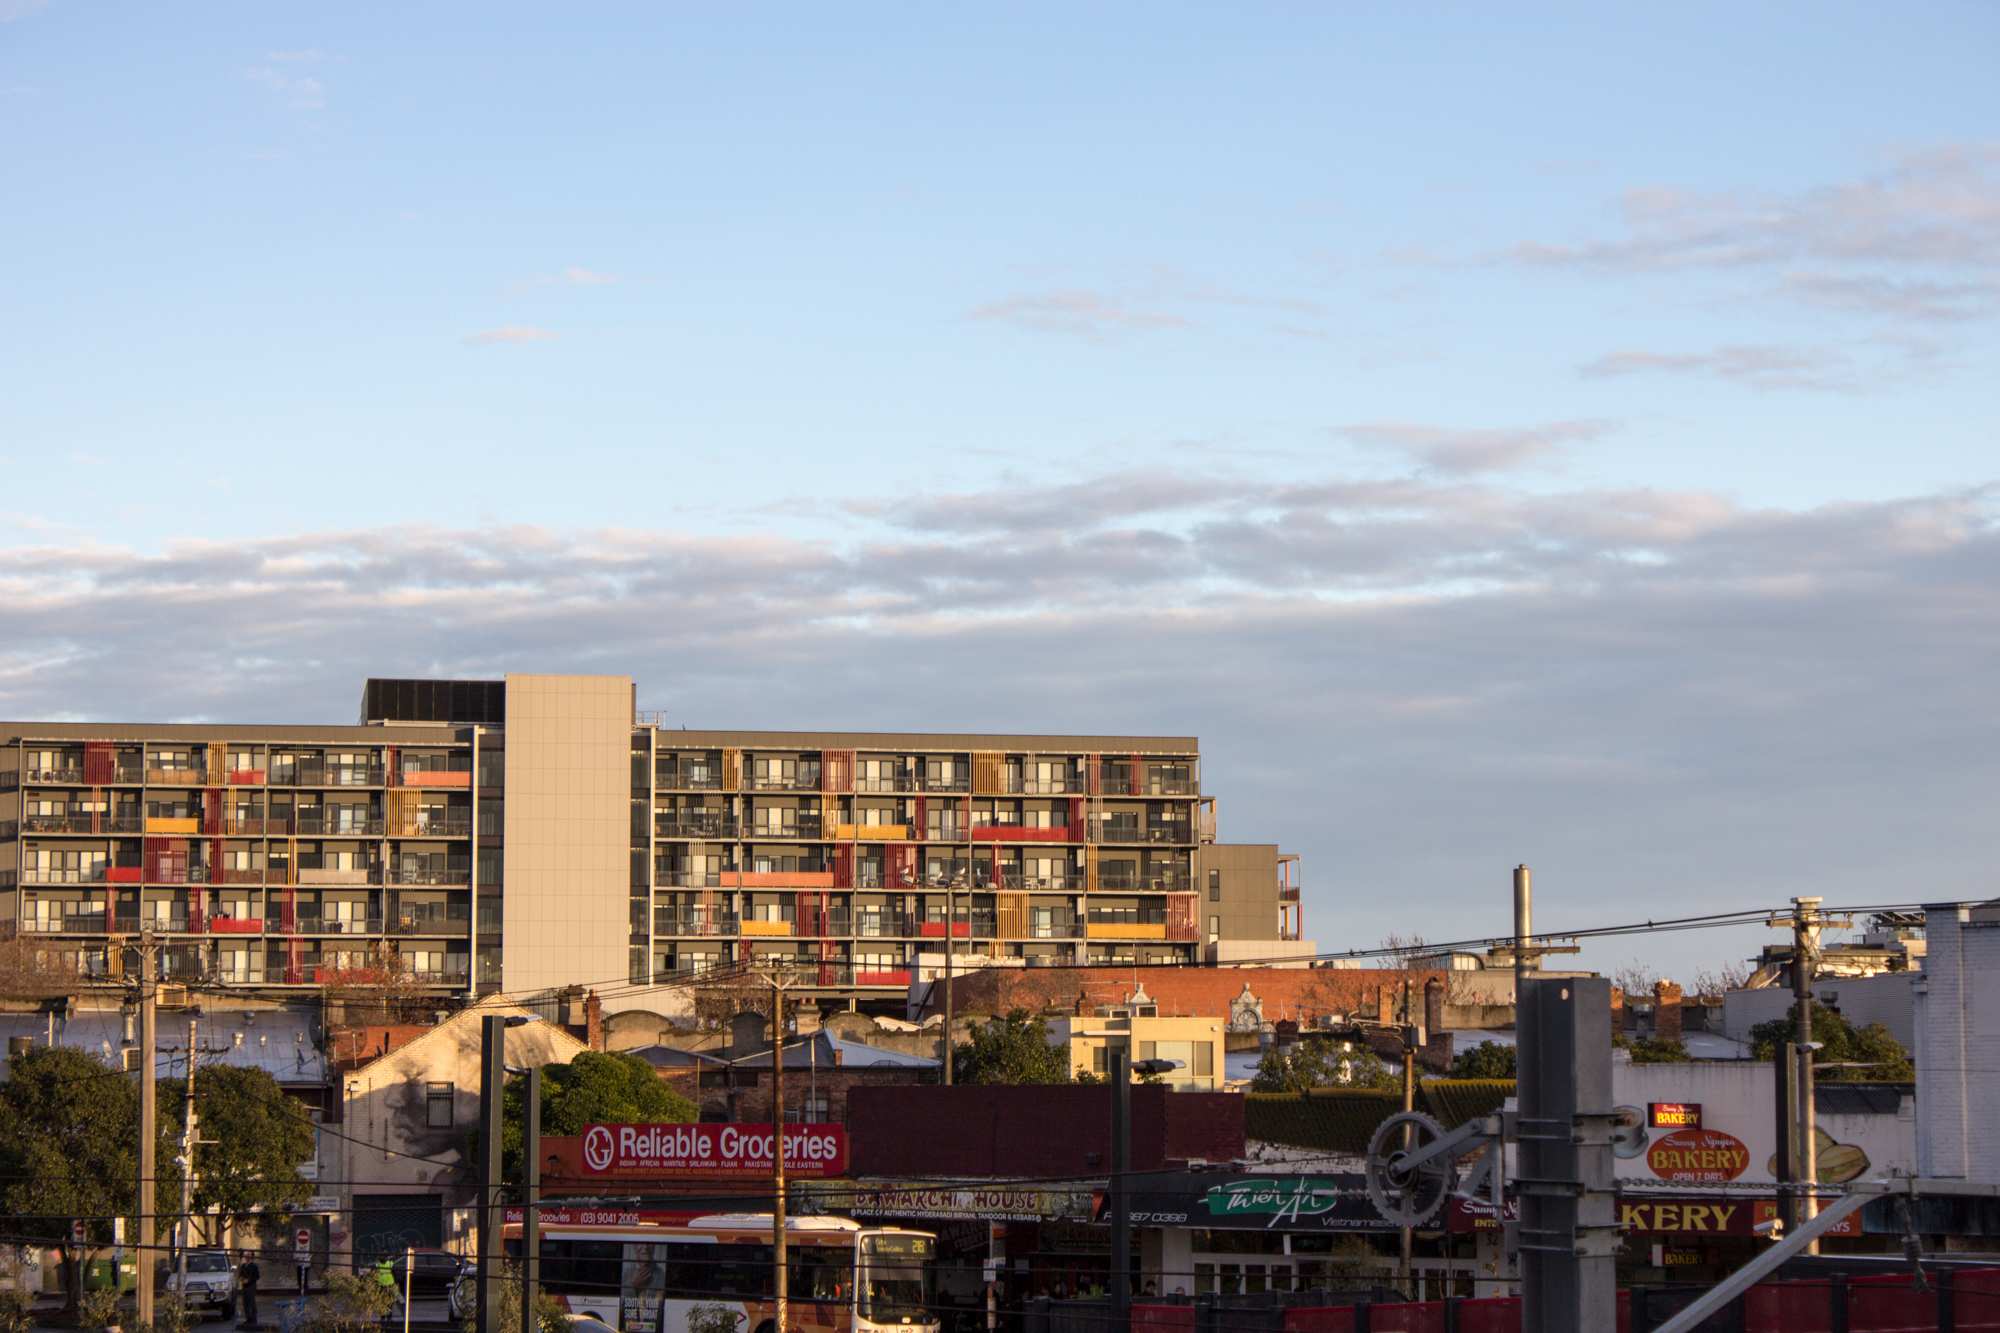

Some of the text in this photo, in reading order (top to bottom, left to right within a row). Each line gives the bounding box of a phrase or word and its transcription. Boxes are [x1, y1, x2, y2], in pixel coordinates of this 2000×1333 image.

[1657, 1112, 1698, 1125] BAKERY
[619, 1126, 837, 1160] Reliable Groceries
[797, 1160, 825, 1169] EASTERN
[1652, 1150, 1745, 1169] BAKERY
[1673, 1172, 1695, 1182] OPEN
[1704, 1172, 1724, 1182] DAYS
[855, 1187, 1037, 1210] BAWARCHI HOUSE
[580, 1212, 596, 1225] (03)
[597, 1213, 616, 1225] 9041
[883, 1210, 916, 1218] AUTHENTIC
[977, 1213, 1006, 1221] TANDOOR
[1620, 1203, 1737, 1231] KERY
